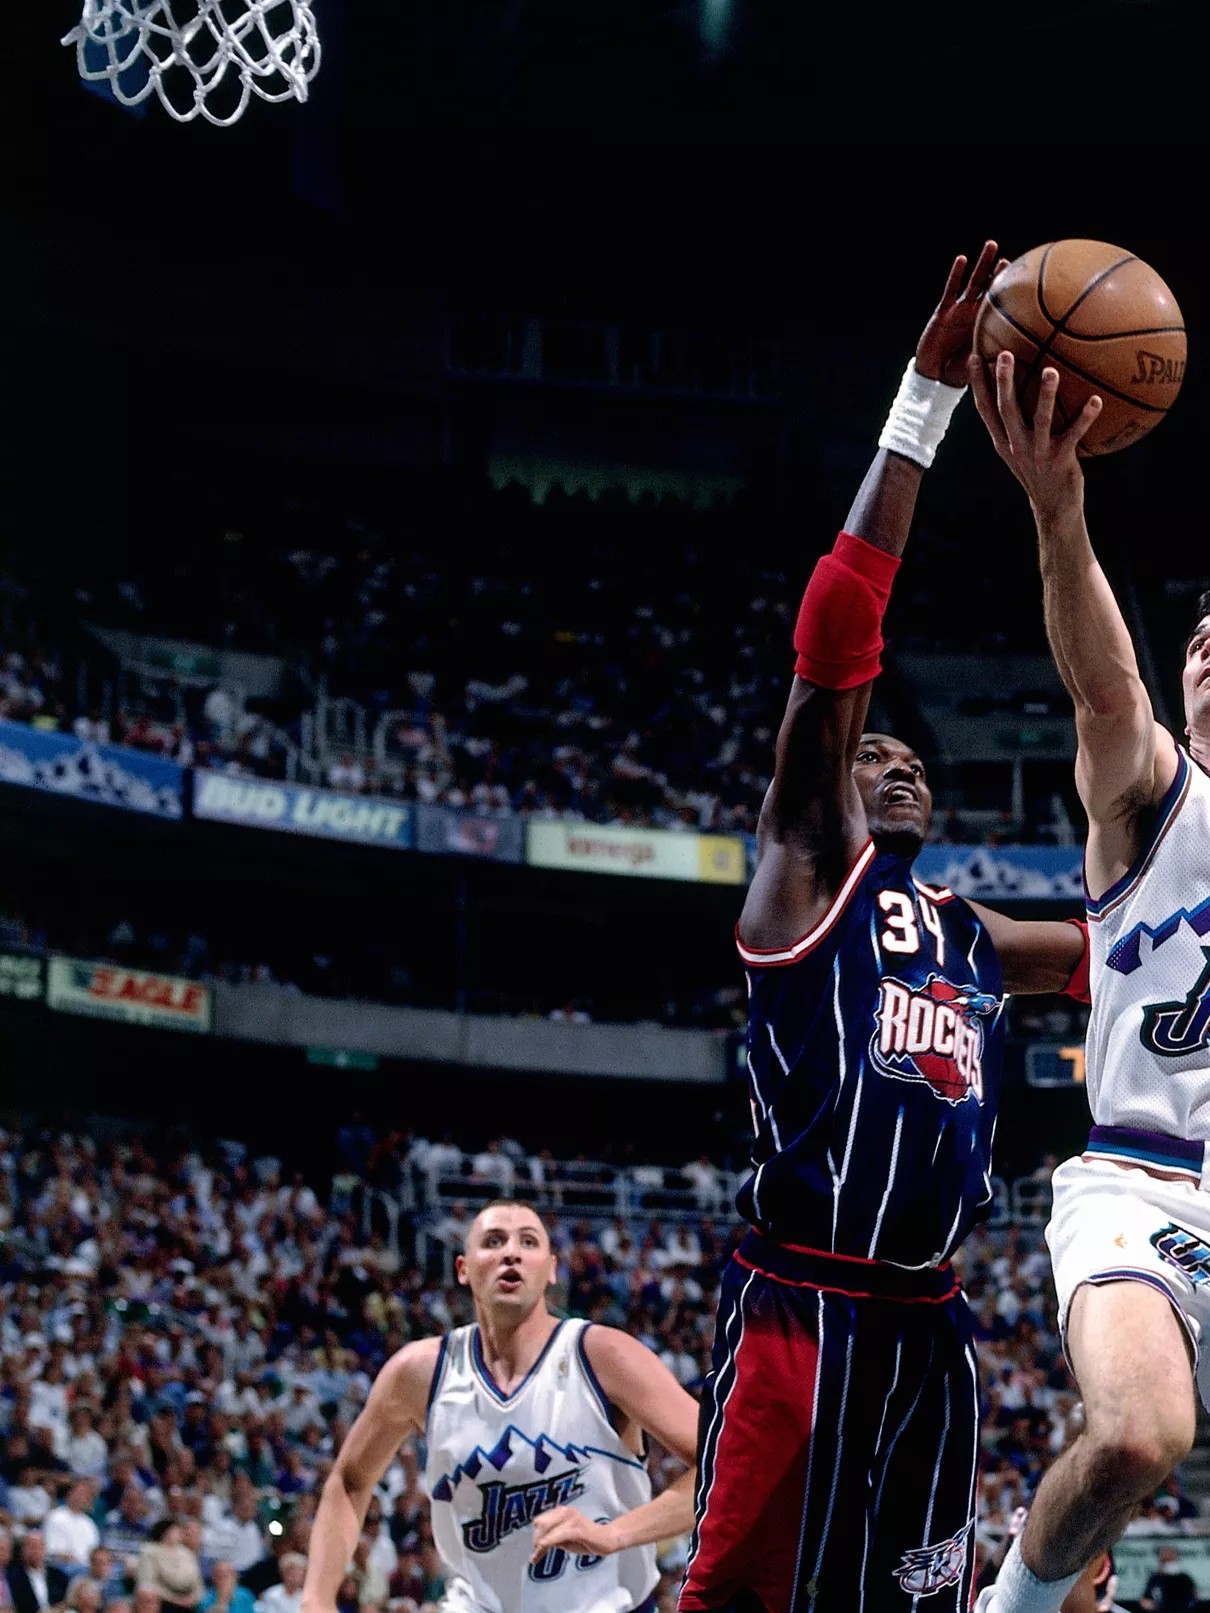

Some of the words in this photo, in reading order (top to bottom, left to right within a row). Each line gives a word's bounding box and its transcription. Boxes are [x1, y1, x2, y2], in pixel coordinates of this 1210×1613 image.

[202, 775, 287, 819] BUD
[294, 791, 409, 838] LIGHT
[878, 888, 945, 968] 34
[90, 968, 208, 1015] EAGLE
